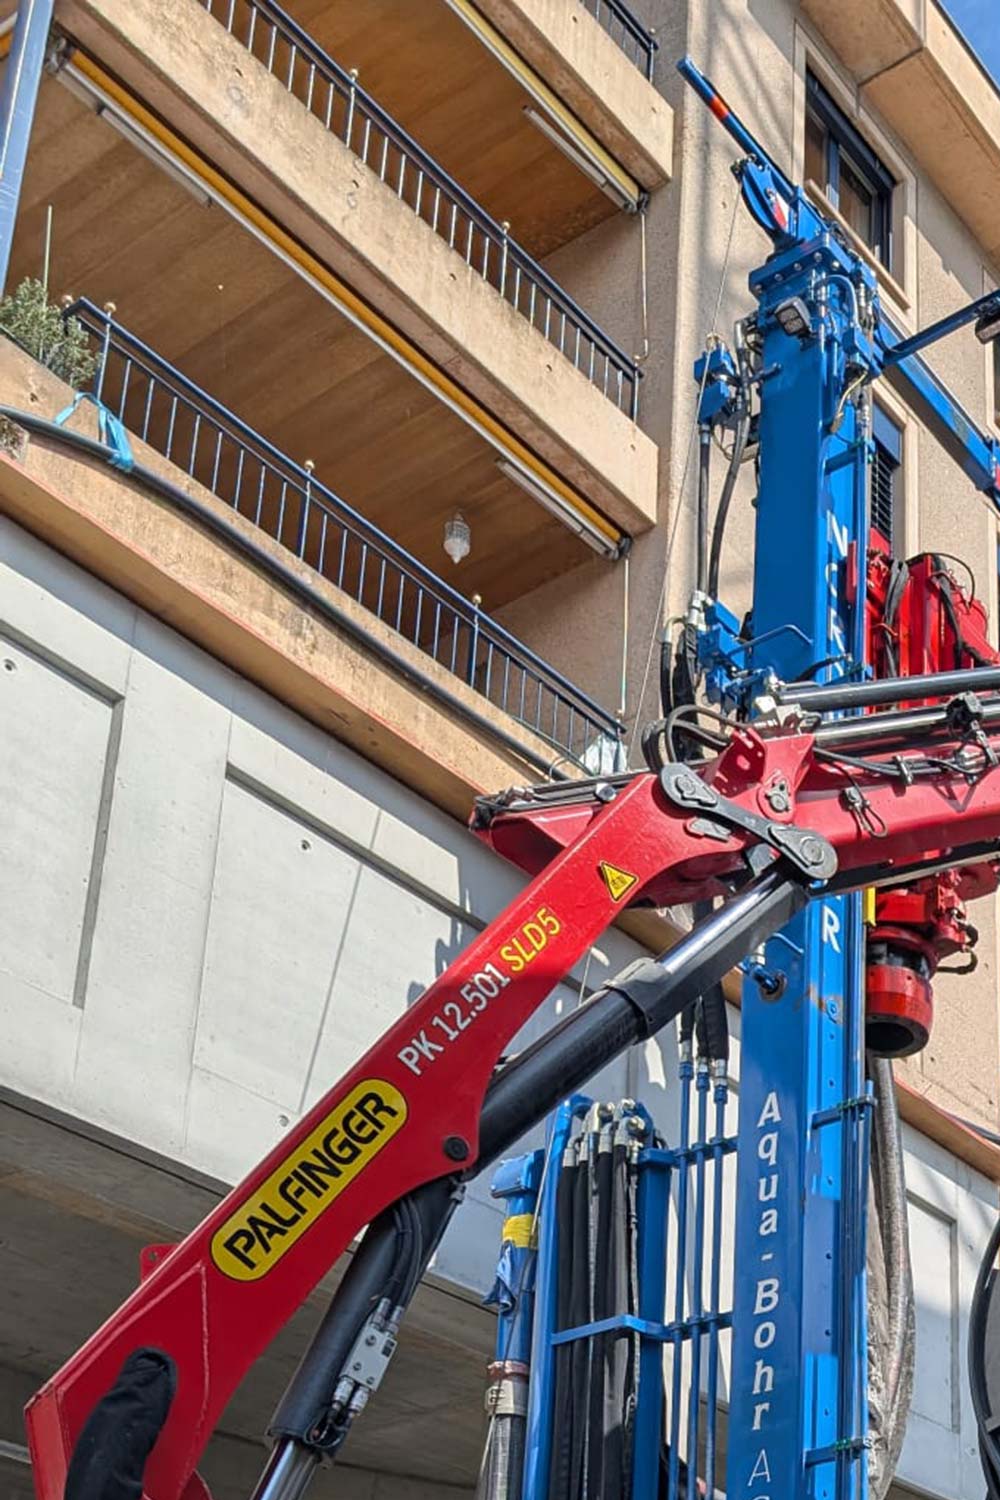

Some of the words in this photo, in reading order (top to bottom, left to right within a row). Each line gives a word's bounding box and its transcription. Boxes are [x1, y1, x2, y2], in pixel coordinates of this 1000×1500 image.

[397, 1029, 445, 1076] PK
[432, 963, 511, 1042] 12.501
[499, 907, 562, 972] SLD5
[223, 1091, 399, 1271] PALFINGER
[752, 1091, 781, 1432] Aqua-Bohr
